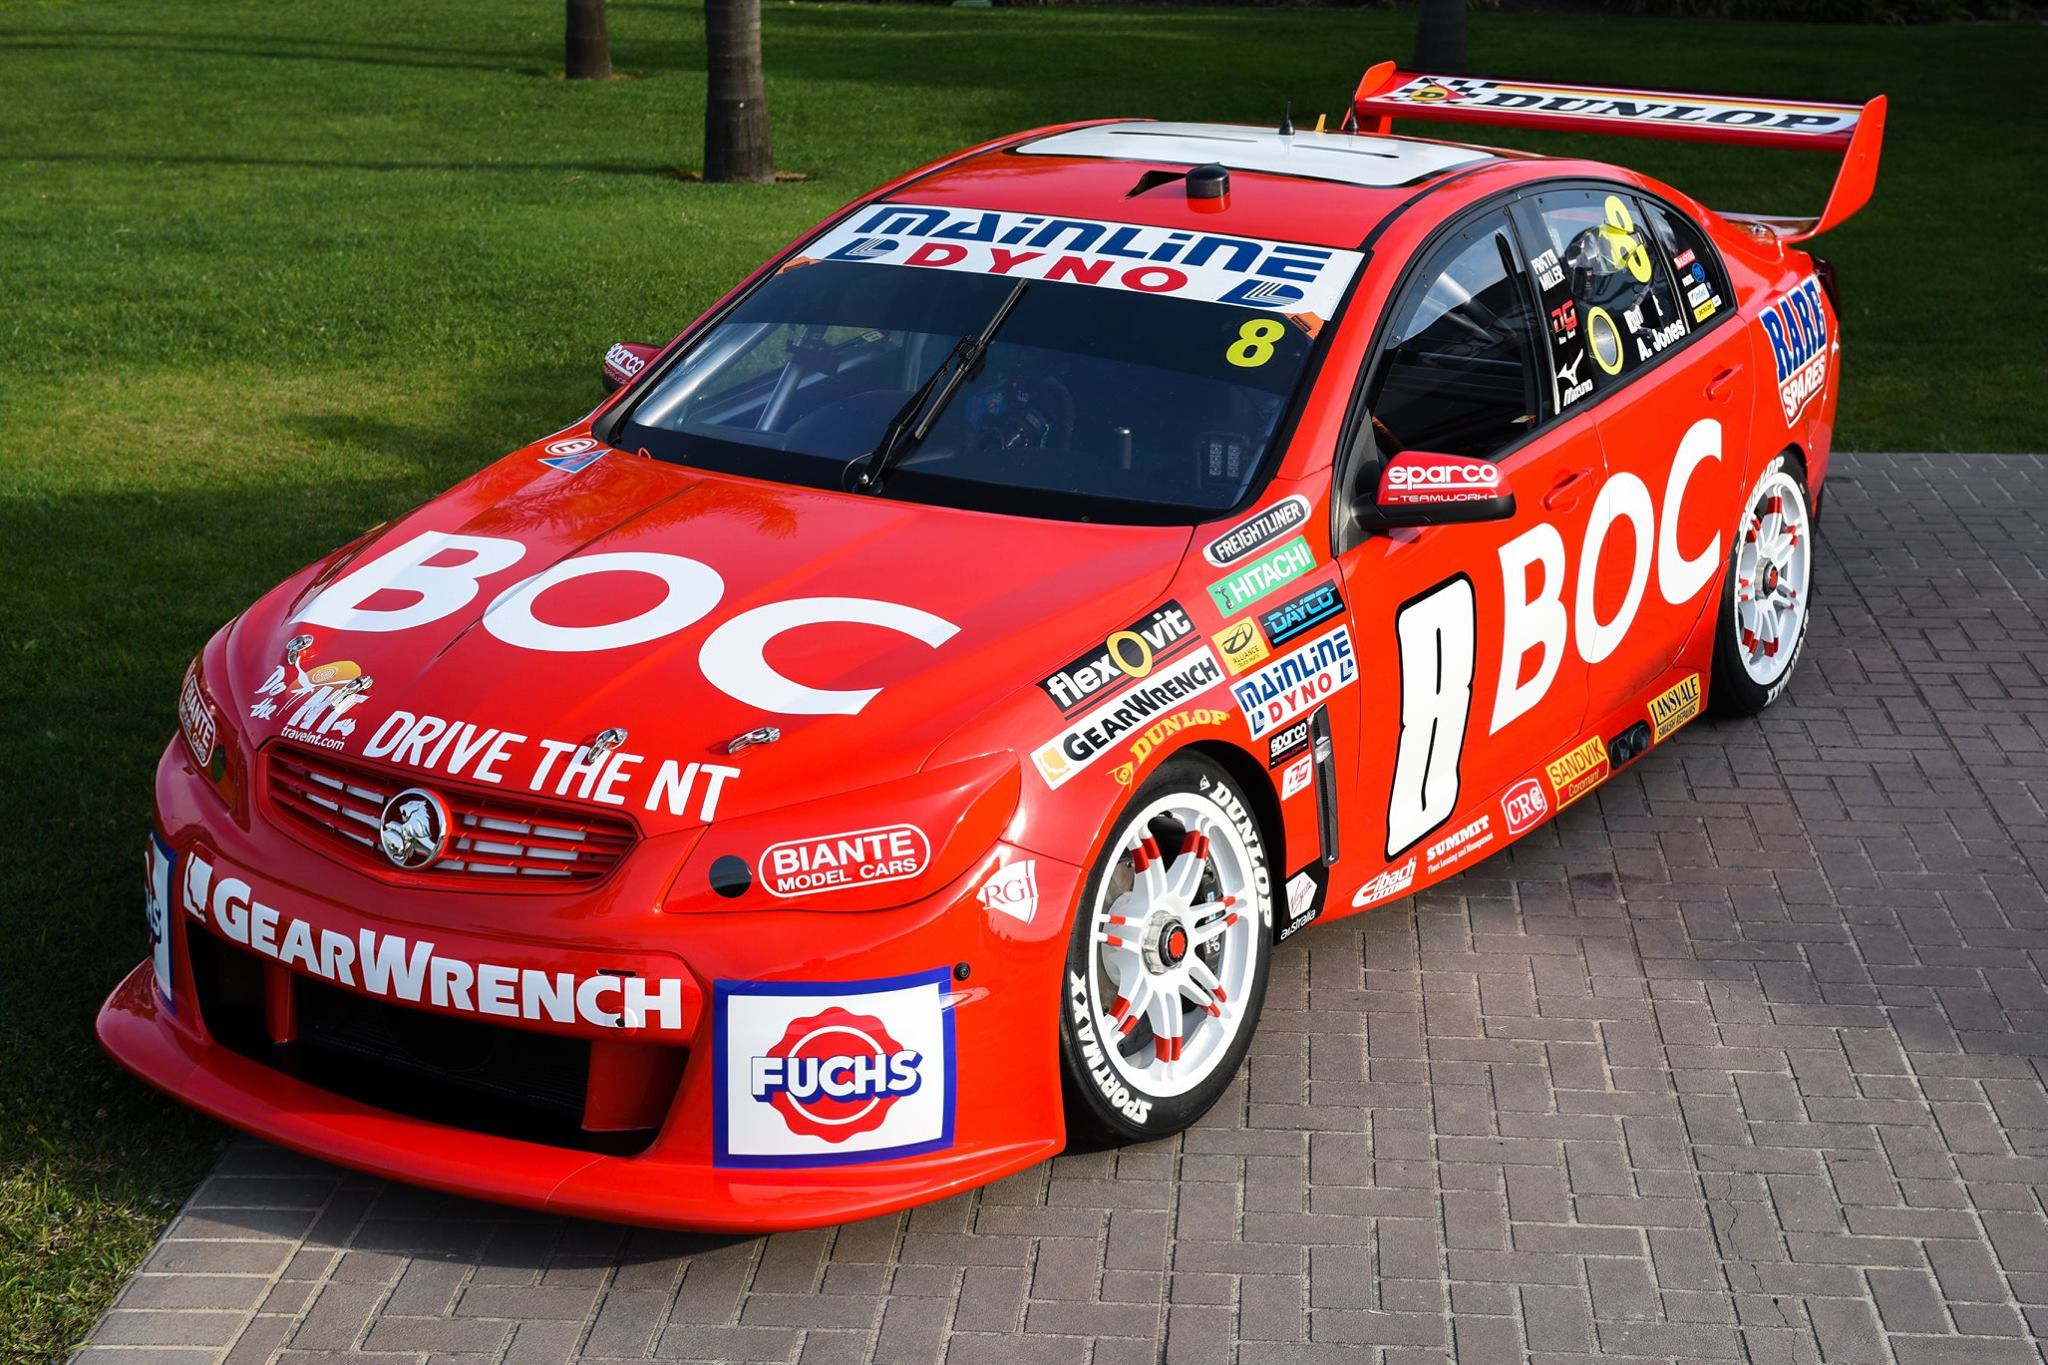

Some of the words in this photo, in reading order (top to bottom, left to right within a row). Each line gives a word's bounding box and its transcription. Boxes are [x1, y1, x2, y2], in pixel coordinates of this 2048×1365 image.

[1476, 93, 1842, 129] DUNLOP
[854, 206, 1331, 283] MAINLINE
[902, 241, 1189, 293] DYNO
[1226, 319, 1285, 368] 8
[1636, 337, 1653, 361] A.
[1653, 319, 1686, 352] Jones
[1758, 274, 1827, 384] RARE
[1782, 353, 1825, 418] SPARES
[1388, 464, 1498, 490] sparco
[1400, 493, 1488, 503] TEAMWORK
[1215, 502, 1302, 561] FREIGHTLINER
[1230, 542, 1312, 603] HITACHI
[1489, 419, 1722, 736] BOC
[290, 530, 962, 715] BOC
[1265, 585, 1338, 634] DAYCO
[254, 665, 288, 696] Do
[1234, 630, 1351, 712] MAINLINE
[250, 698, 277, 720] the
[1268, 673, 1332, 724] DYNO
[1650, 675, 1700, 727] LANSVALE
[281, 725, 345, 751] travelnt.com
[1130, 709, 1231, 764] DUNLOP
[1270, 722, 1307, 754] sparco
[362, 711, 528, 784] DRIVE
[529, 739, 645, 806] THE
[644, 759, 742, 822] NT
[1550, 738, 1605, 786] SANDVIK
[1507, 786, 1544, 825] CRC
[772, 830, 916, 875] BIANTE
[1208, 781, 1272, 928] DUNLOP
[1426, 814, 1489, 862] SUMMIT
[777, 869, 852, 893] MODEL
[860, 857, 918, 880] CARS
[982, 874, 1039, 911] RGI
[1280, 908, 1317, 942] australia
[1069, 971, 1152, 1125] SPORTMAXX
[752, 1050, 923, 1103] FUCHS
